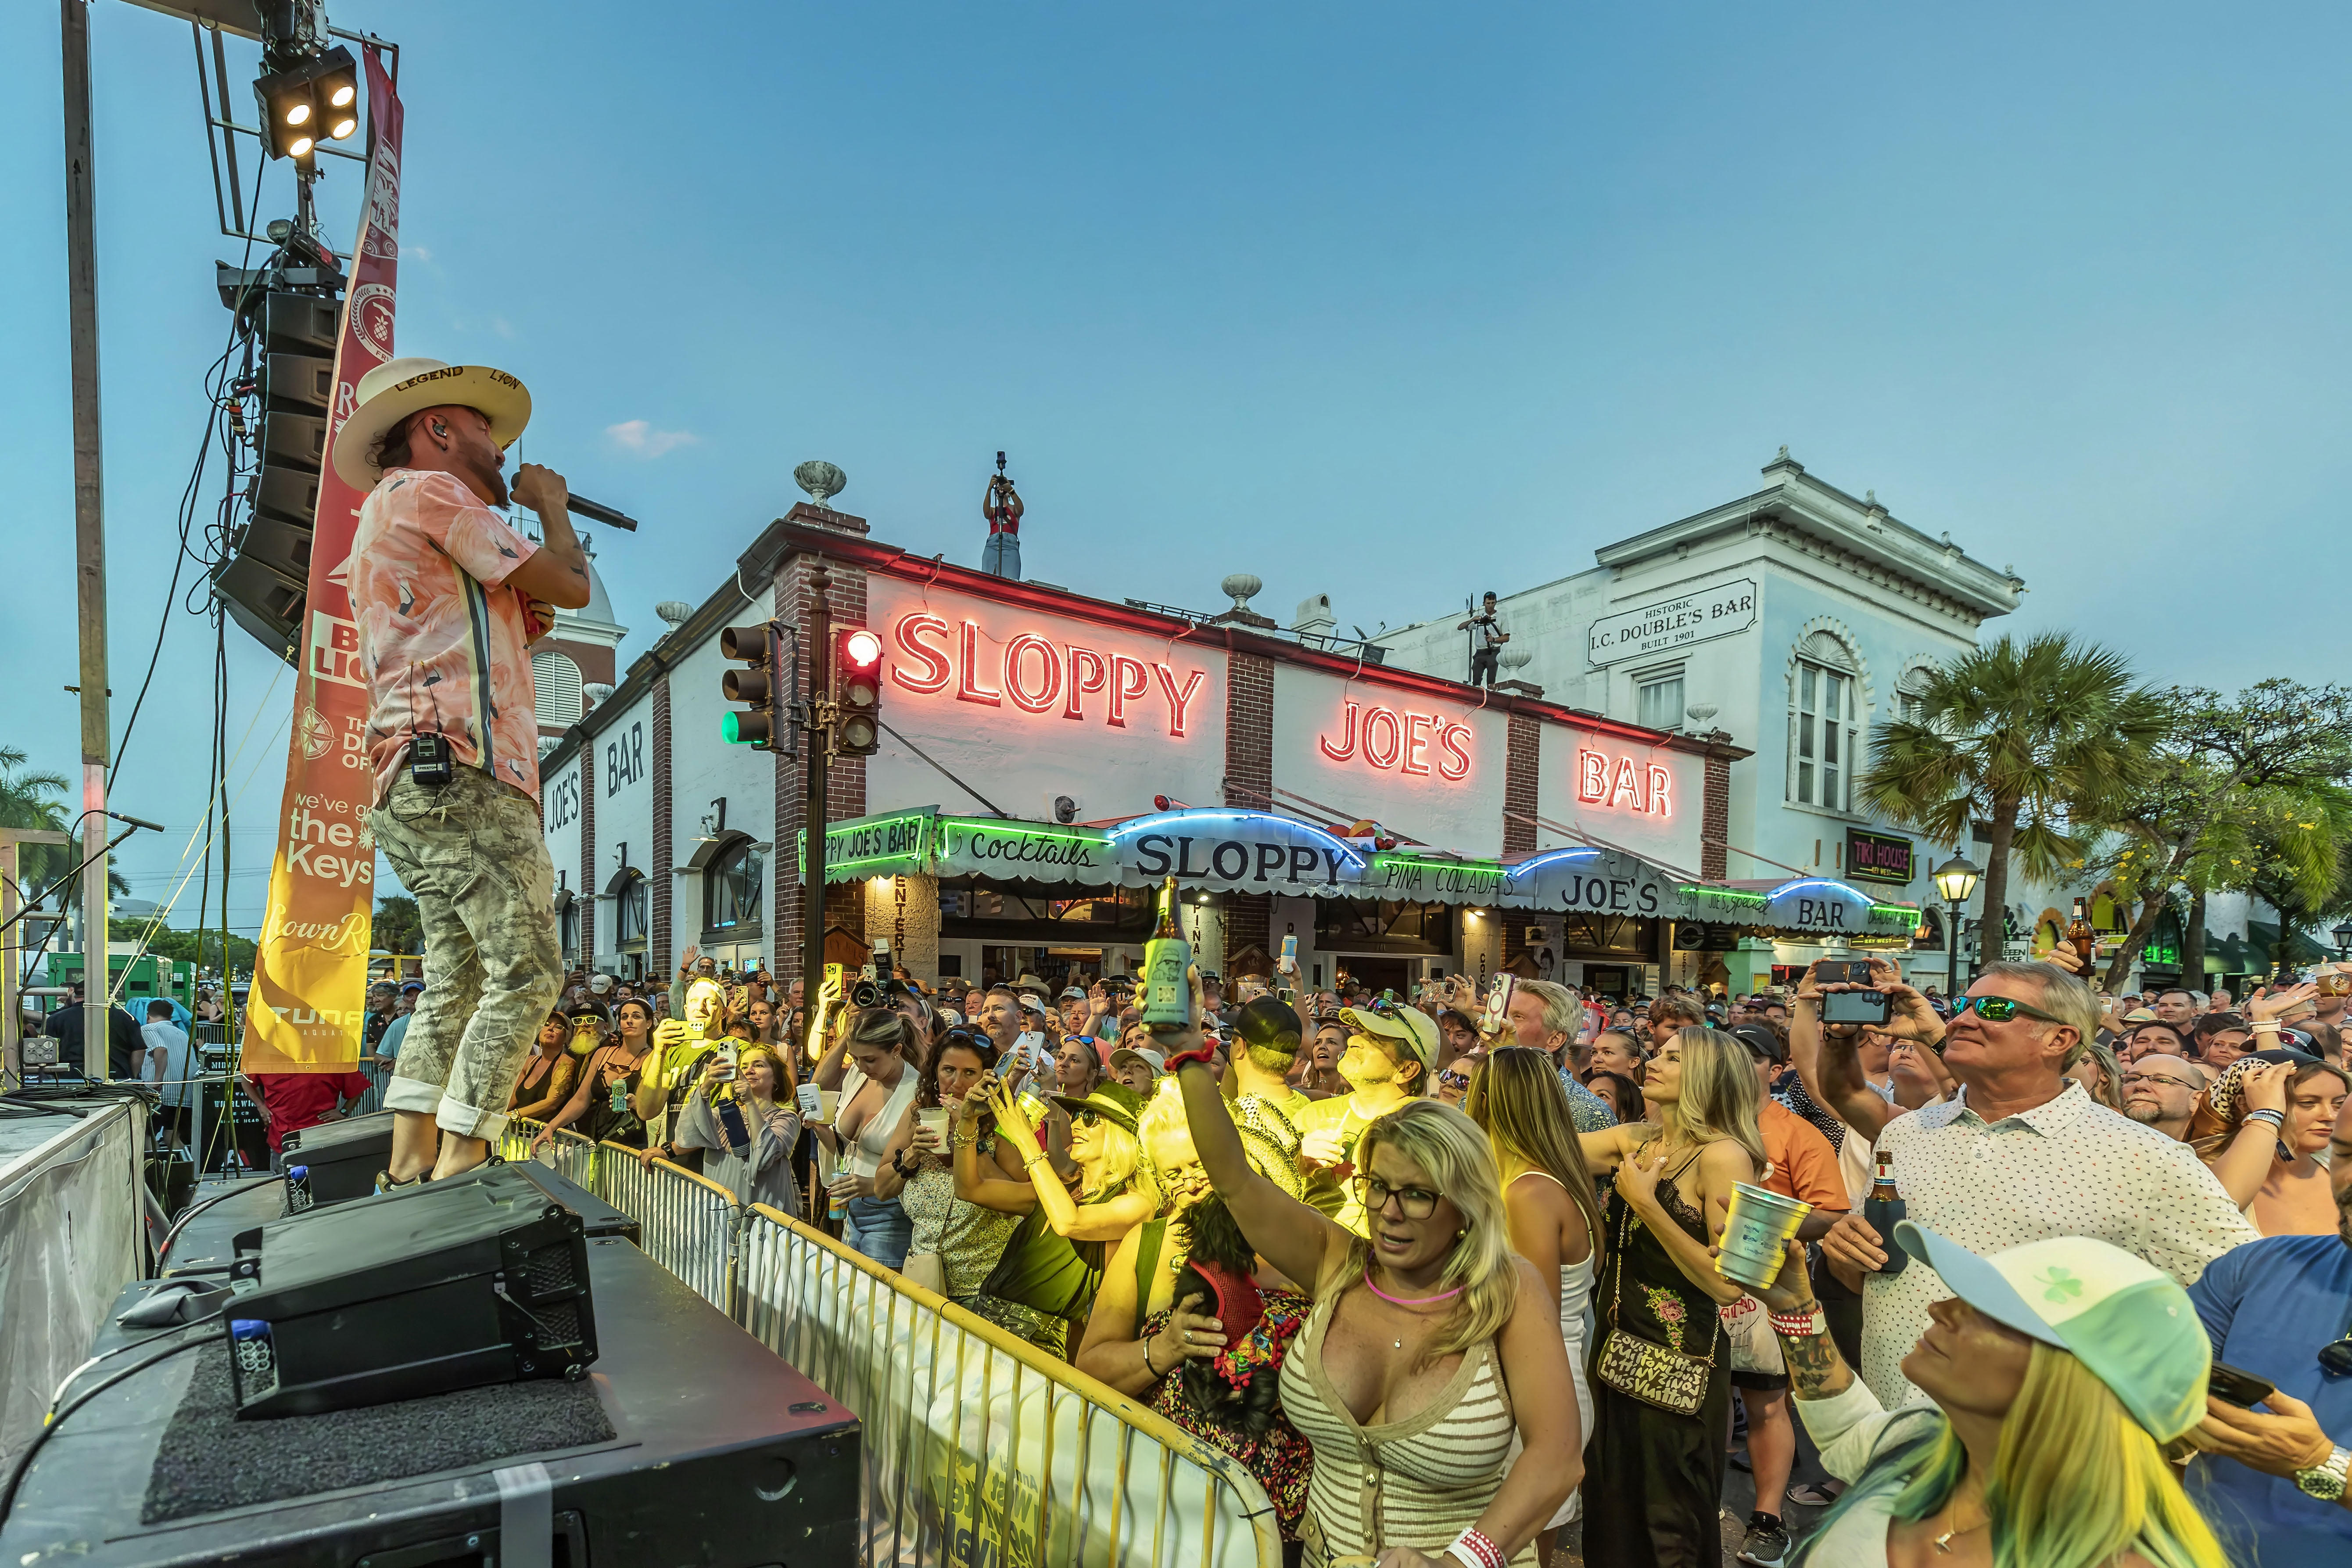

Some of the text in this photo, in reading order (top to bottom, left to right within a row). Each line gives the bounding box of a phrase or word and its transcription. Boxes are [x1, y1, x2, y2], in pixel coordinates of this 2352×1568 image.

[394, 366, 464, 392] LEGEND
[489, 369, 520, 390] LION
[1591, 596, 1752, 650] I.C. DOUBLE'S BAR
[1645, 599, 1693, 619] HISTORIC
[1641, 630, 1695, 650] BUILT 1901
[892, 613, 1672, 818] SLOPPY JOE'S BAR
[549, 721, 643, 833] JOE'S BAR
[295, 792, 348, 813] we've
[290, 807, 353, 847] the
[848, 825, 882, 858] JOE'S
[888, 822, 918, 853] BAR
[286, 840, 372, 888] Keys
[971, 832, 1099, 868] Cocktails
[1854, 840, 1909, 870] TIKI HOUSE
[1136, 835, 1844, 927] SLOPPY JOE'S BAR
[1676, 890, 1700, 906] SLOPPY
[1709, 893, 1726, 911] JOE'S
[271, 1007, 364, 1026] TUNA
